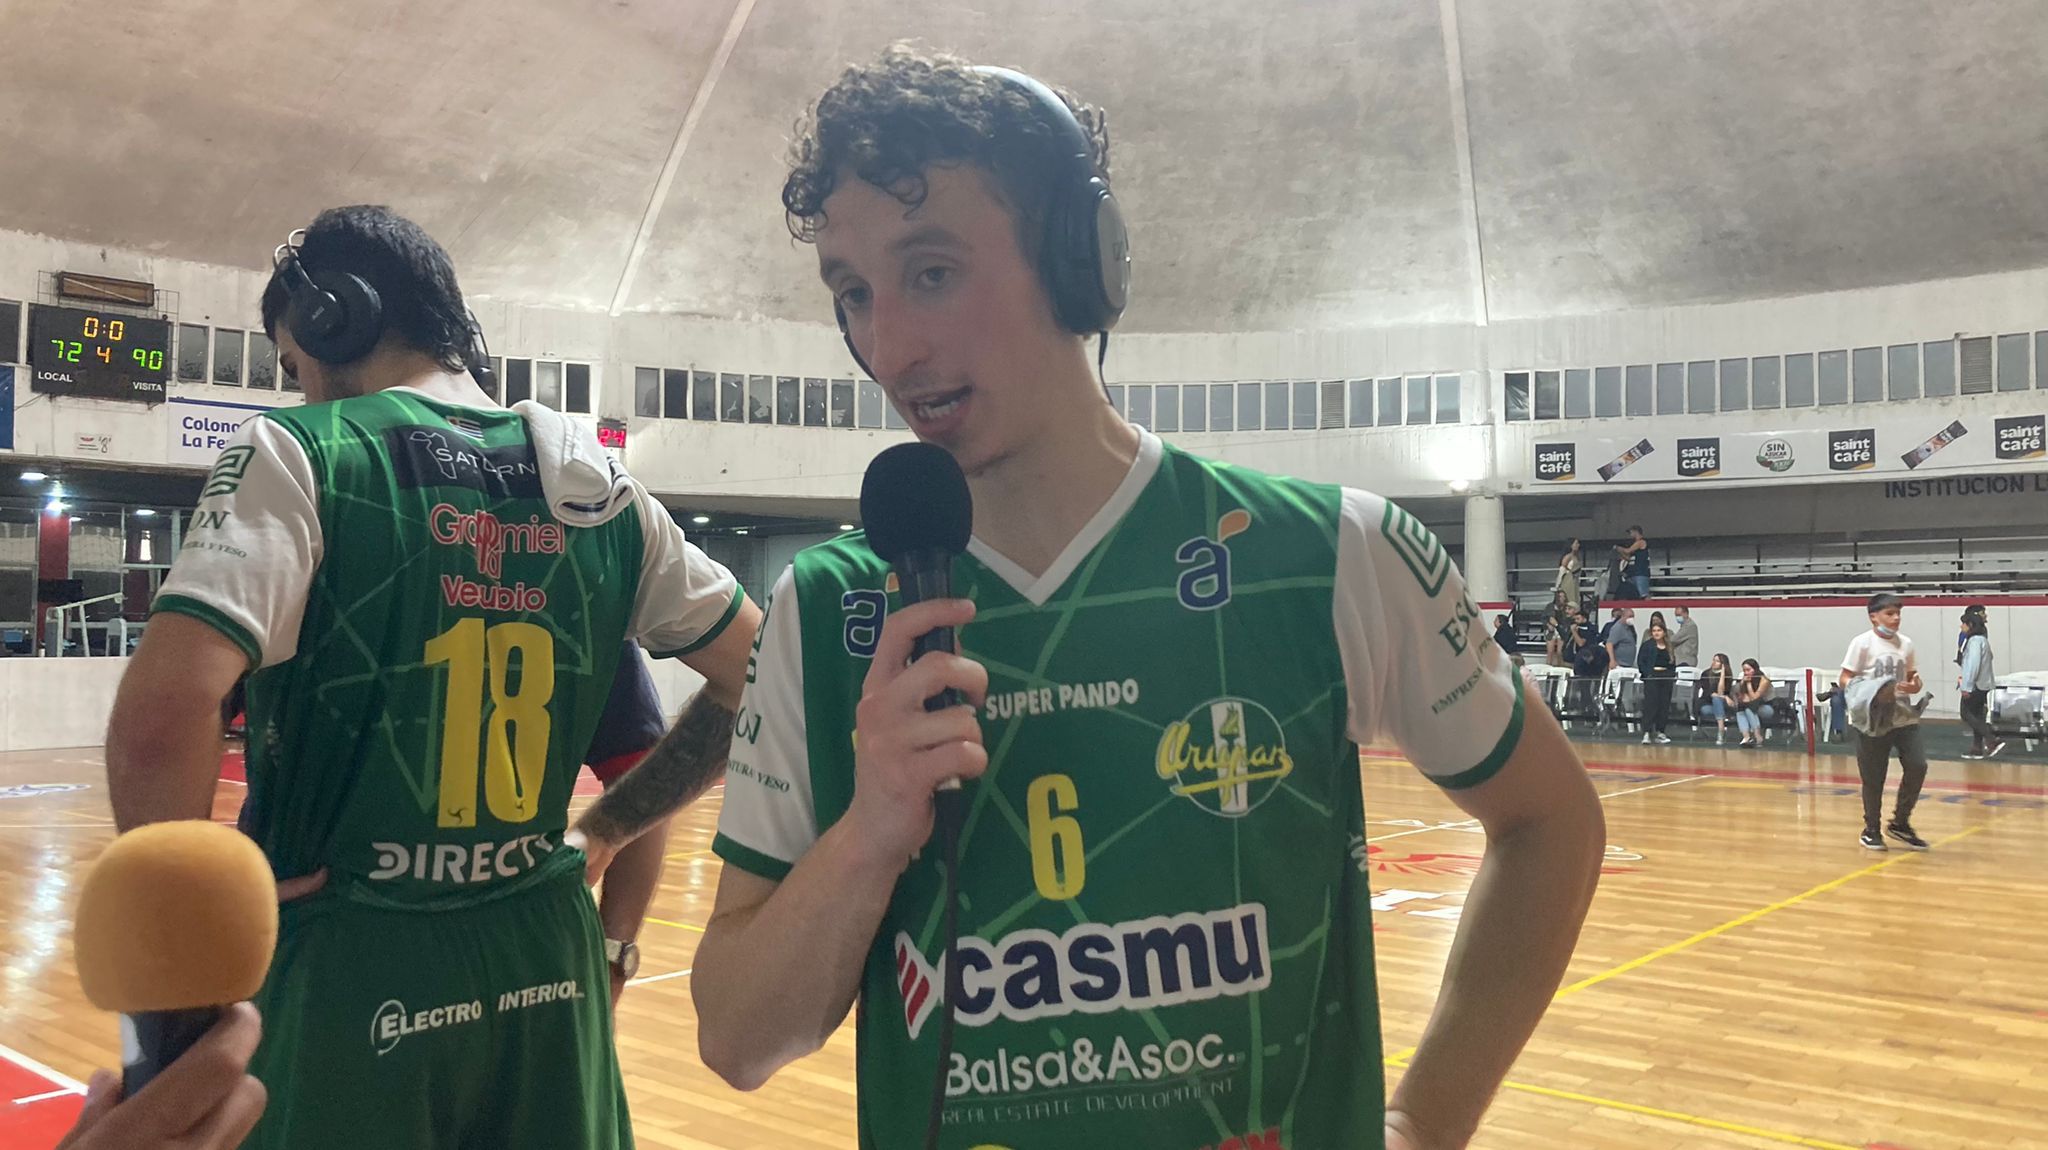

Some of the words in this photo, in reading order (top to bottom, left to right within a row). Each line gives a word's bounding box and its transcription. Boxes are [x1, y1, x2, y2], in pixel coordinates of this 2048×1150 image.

[84, 316, 124, 341] 0:0
[51, 339, 82, 363] 72
[96, 346, 111, 363] 4
[132, 348, 163, 370] 90
[38, 371, 73, 383] LOCAL
[132, 381, 163, 392] VISITA
[599, 427, 627, 447] 24
[2000, 424, 2043, 439] saint
[182, 433, 202, 448] La
[207, 435, 229, 450] Fe
[1766, 443, 1785, 452] SIN
[1833, 438, 1871, 451] saint
[2001, 436, 2041, 451] café
[1538, 450, 1572, 463] saint
[1681, 446, 1716, 459] saint
[1833, 450, 1871, 463] café
[1539, 462, 1572, 474] café
[1682, 457, 1716, 470] café
[1884, 473, 2025, 499] INSTITUCION
[985, 687, 1055, 721] SUPER
[1058, 678, 1140, 709] PANDO
[423, 617, 556, 829] 18
[1026, 773, 1086, 900] 6
[950, 911, 1268, 1016] casmu
[380, 999, 483, 1040] ELECTRO
[944, 1033, 1237, 1098] Balsa&Asoc.
[994, 1099, 1077, 1122] ESTATE
